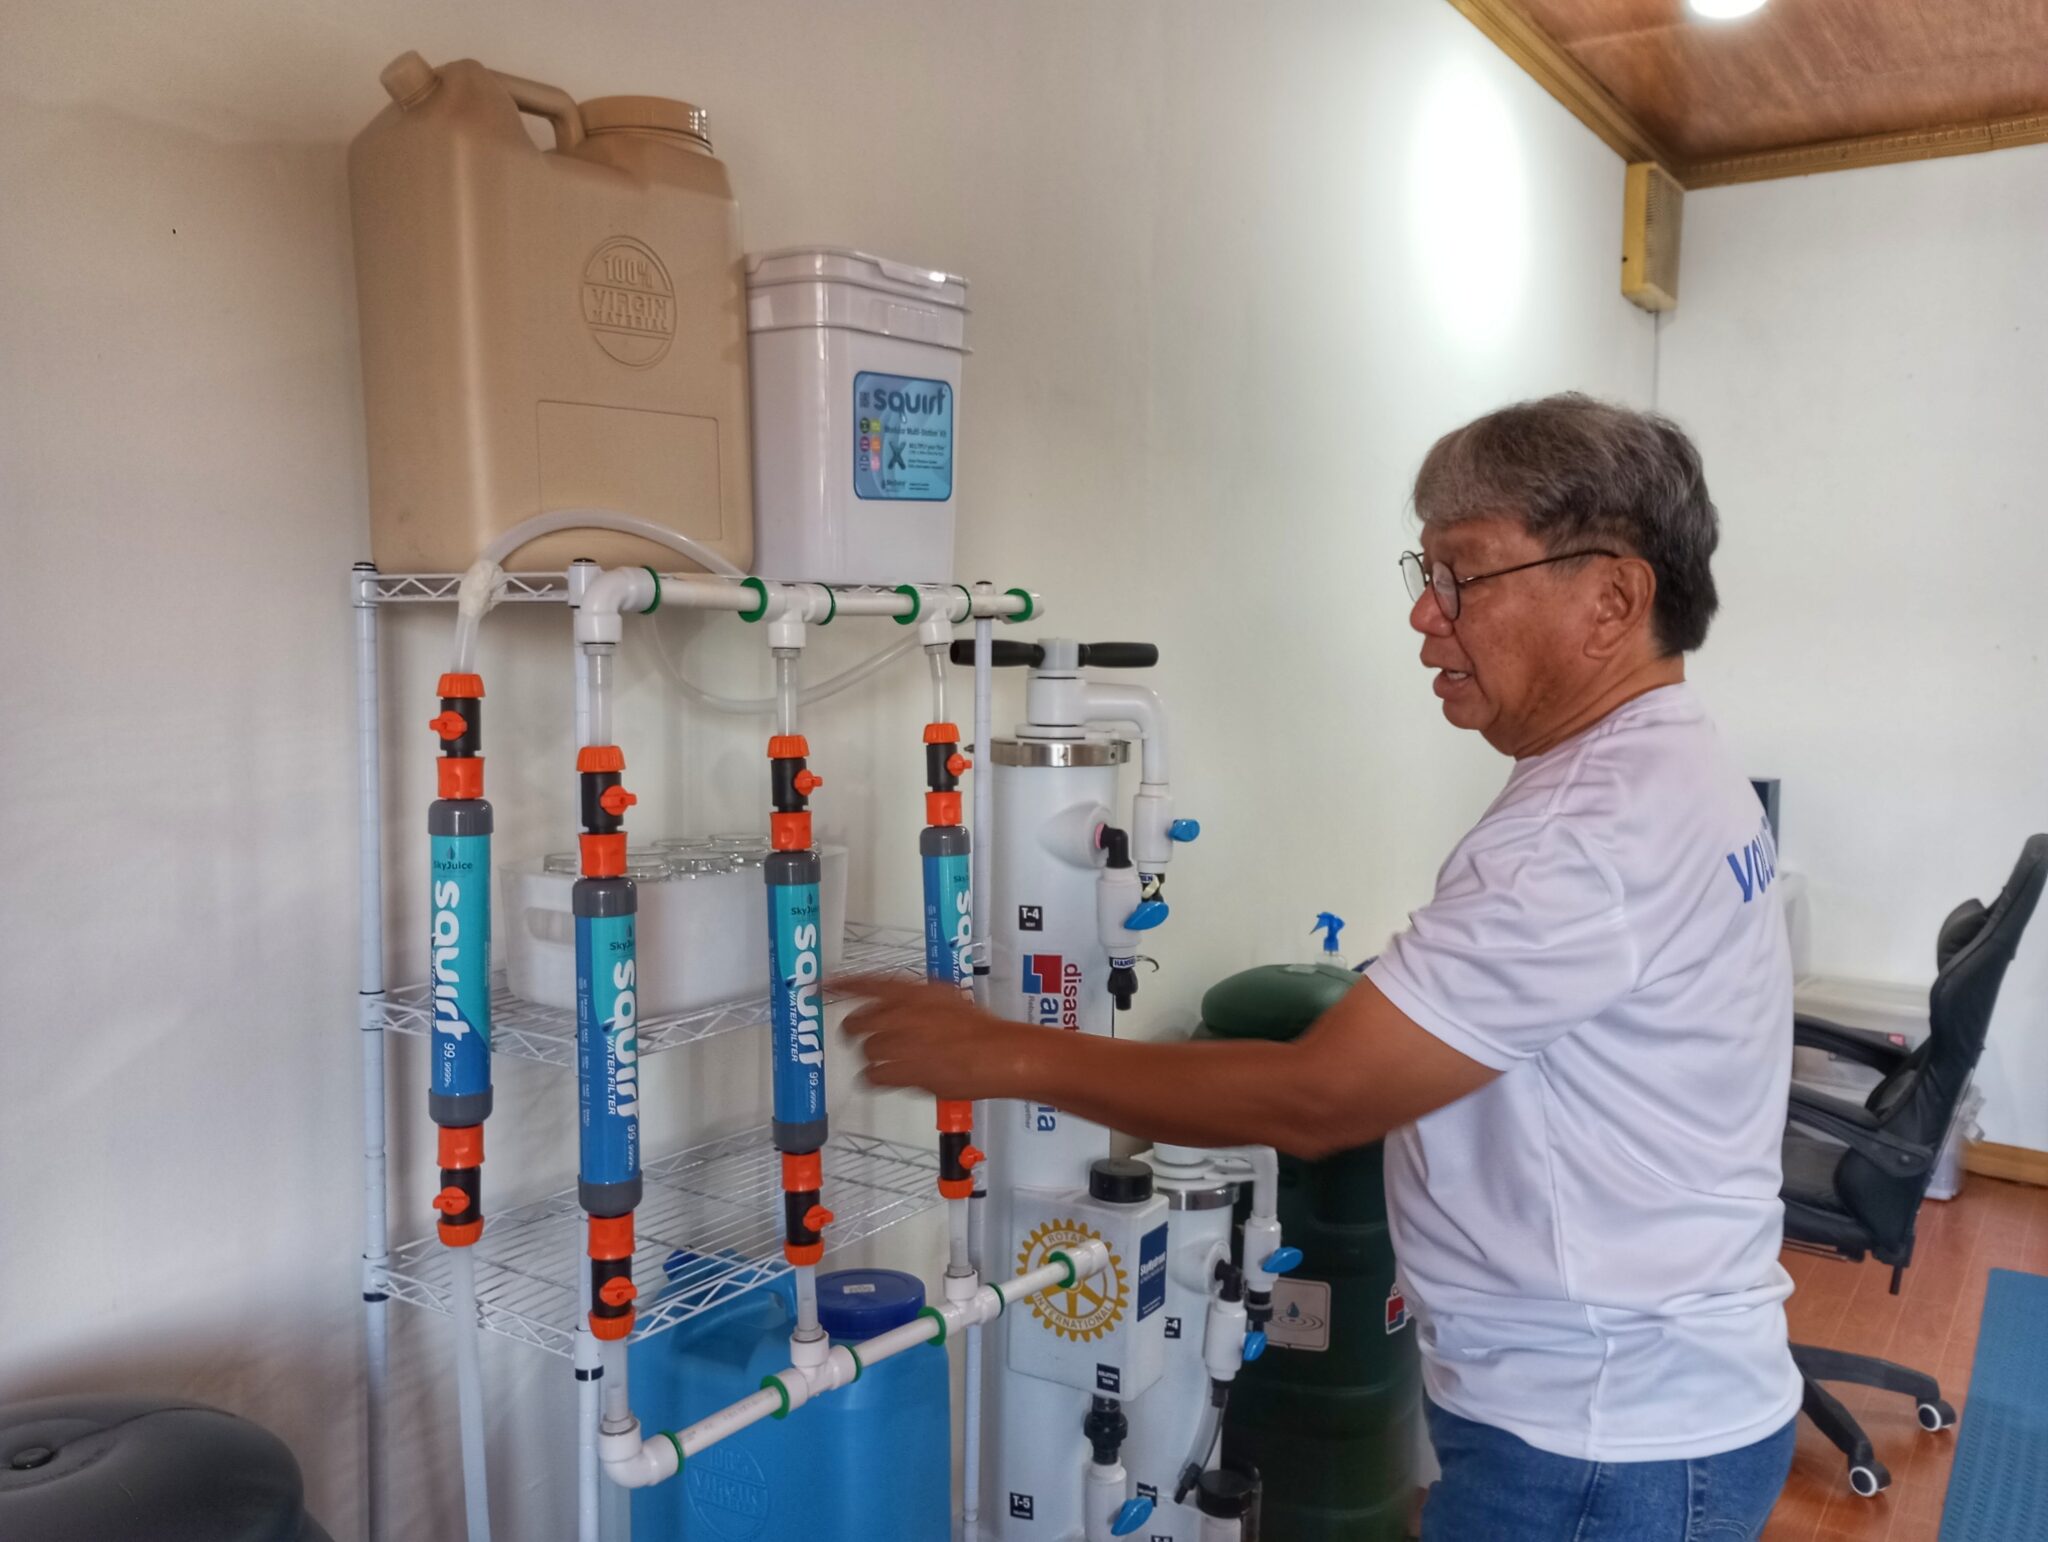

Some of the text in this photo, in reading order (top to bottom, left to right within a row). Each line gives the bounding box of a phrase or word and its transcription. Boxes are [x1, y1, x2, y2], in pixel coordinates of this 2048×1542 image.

[604, 255, 654, 289] 100%
[592, 287, 668, 321] VIRGIN
[873, 387, 946, 420] squirt
[1021, 907, 1039, 919] T-4
[432, 880, 470, 1041] squirt
[787, 924, 824, 1068] squirt
[604, 959, 639, 1120] squirt
[789, 990, 798, 1062] WATER FILTER
[606, 1035, 616, 1115] WATER FILTER
[1034, 1293, 1113, 1328] INTERNATIONAL
[1013, 1495, 1030, 1509] T-5
